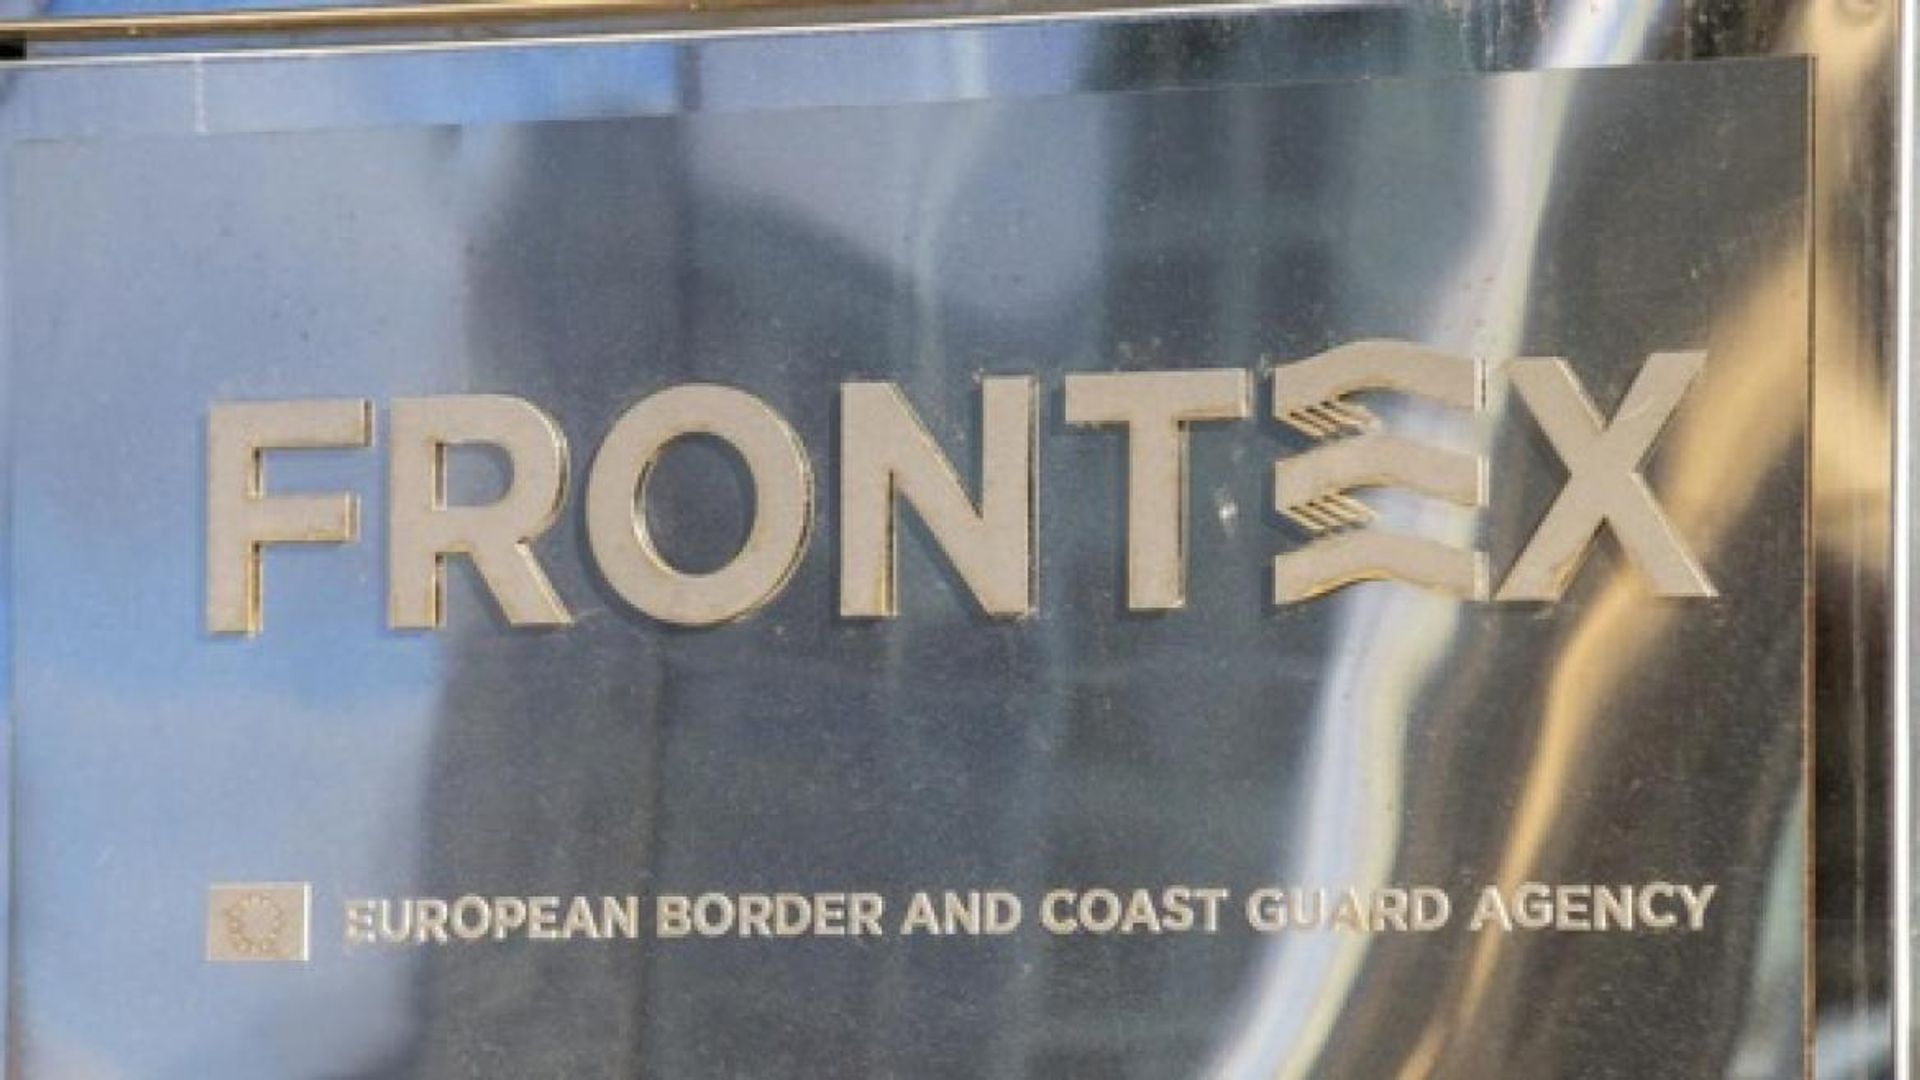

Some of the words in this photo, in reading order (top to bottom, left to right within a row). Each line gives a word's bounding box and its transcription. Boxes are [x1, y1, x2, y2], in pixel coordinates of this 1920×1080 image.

[205, 340, 1719, 635] FRONTEX
[344, 893, 640, 944] EUROPEAN
[656, 893, 884, 938] BORDER
[901, 892, 1022, 935] AND
[1039, 886, 1228, 934] COAST
[1246, 886, 1450, 932] GUARD
[1469, 881, 1719, 931] AGENCY
